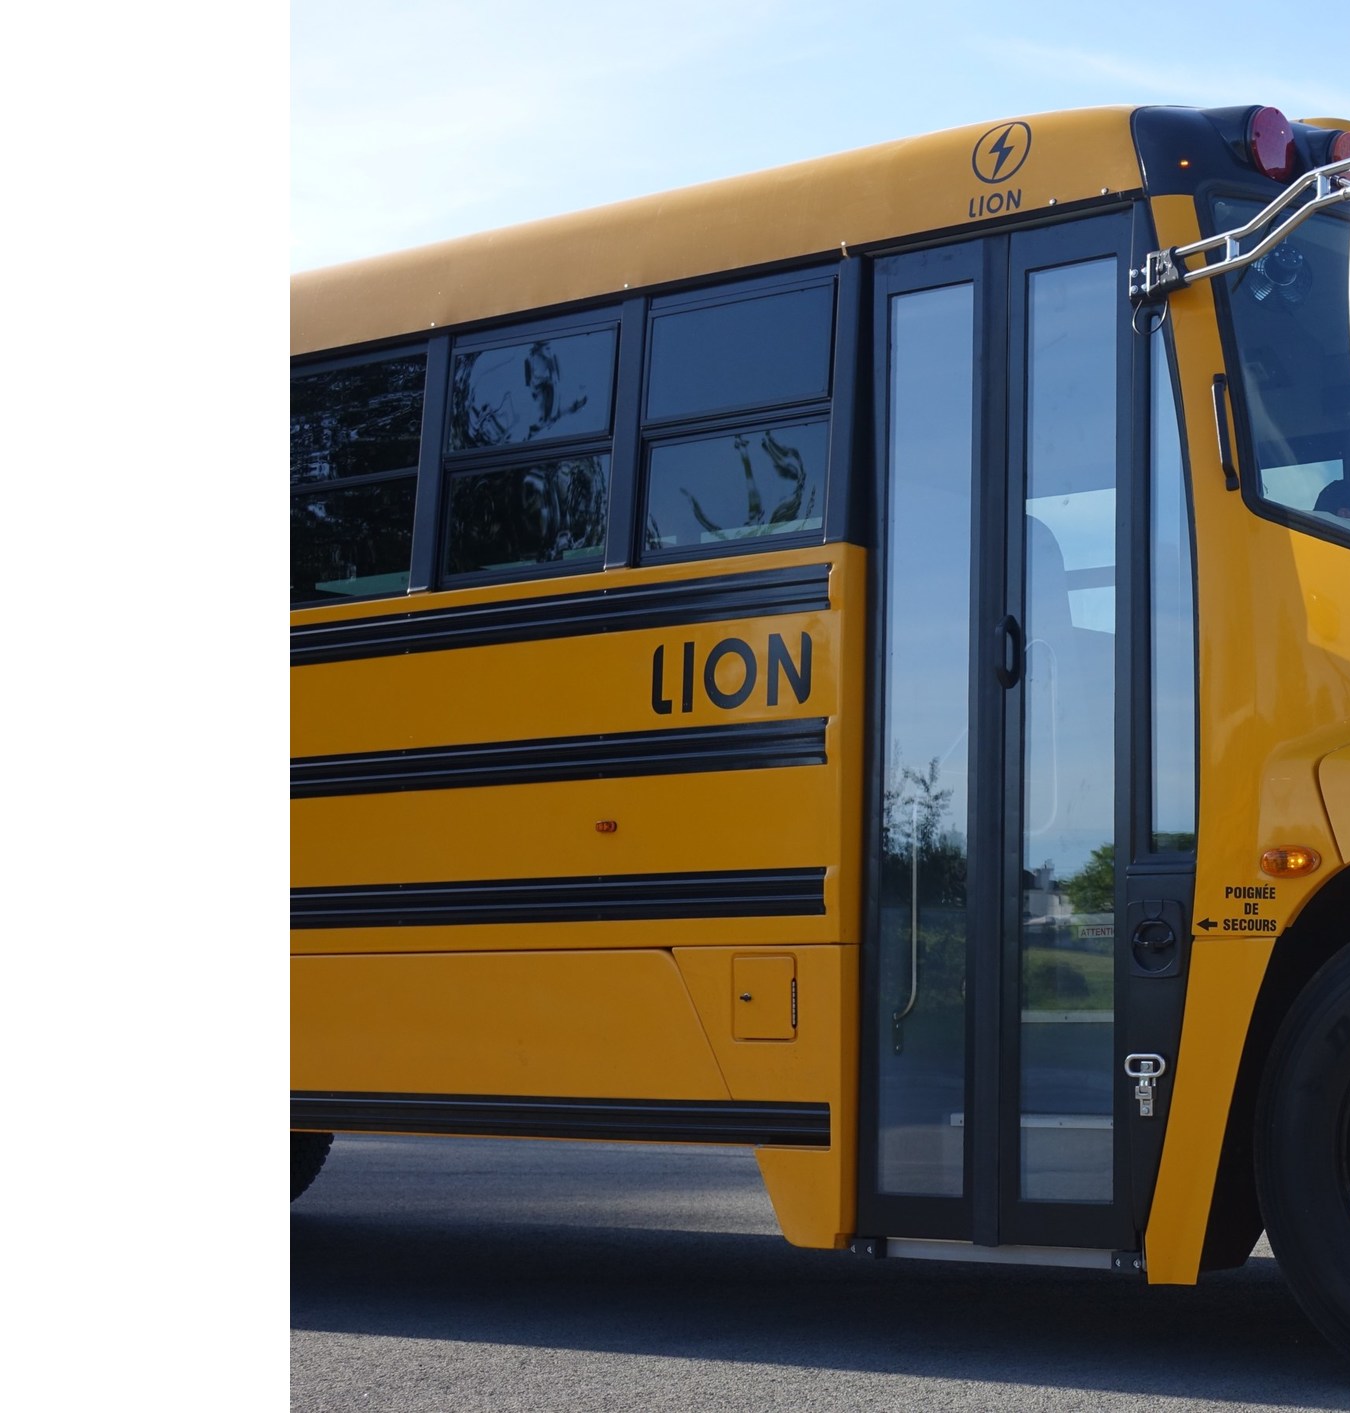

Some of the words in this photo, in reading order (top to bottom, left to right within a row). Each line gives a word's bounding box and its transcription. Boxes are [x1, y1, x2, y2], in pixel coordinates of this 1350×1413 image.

[969, 188, 1021, 217] LION
[652, 631, 812, 714] LION
[1225, 884, 1276, 899] POIGNÉE
[1244, 902, 1259, 915] DE
[1223, 919, 1277, 932] SECOURS
